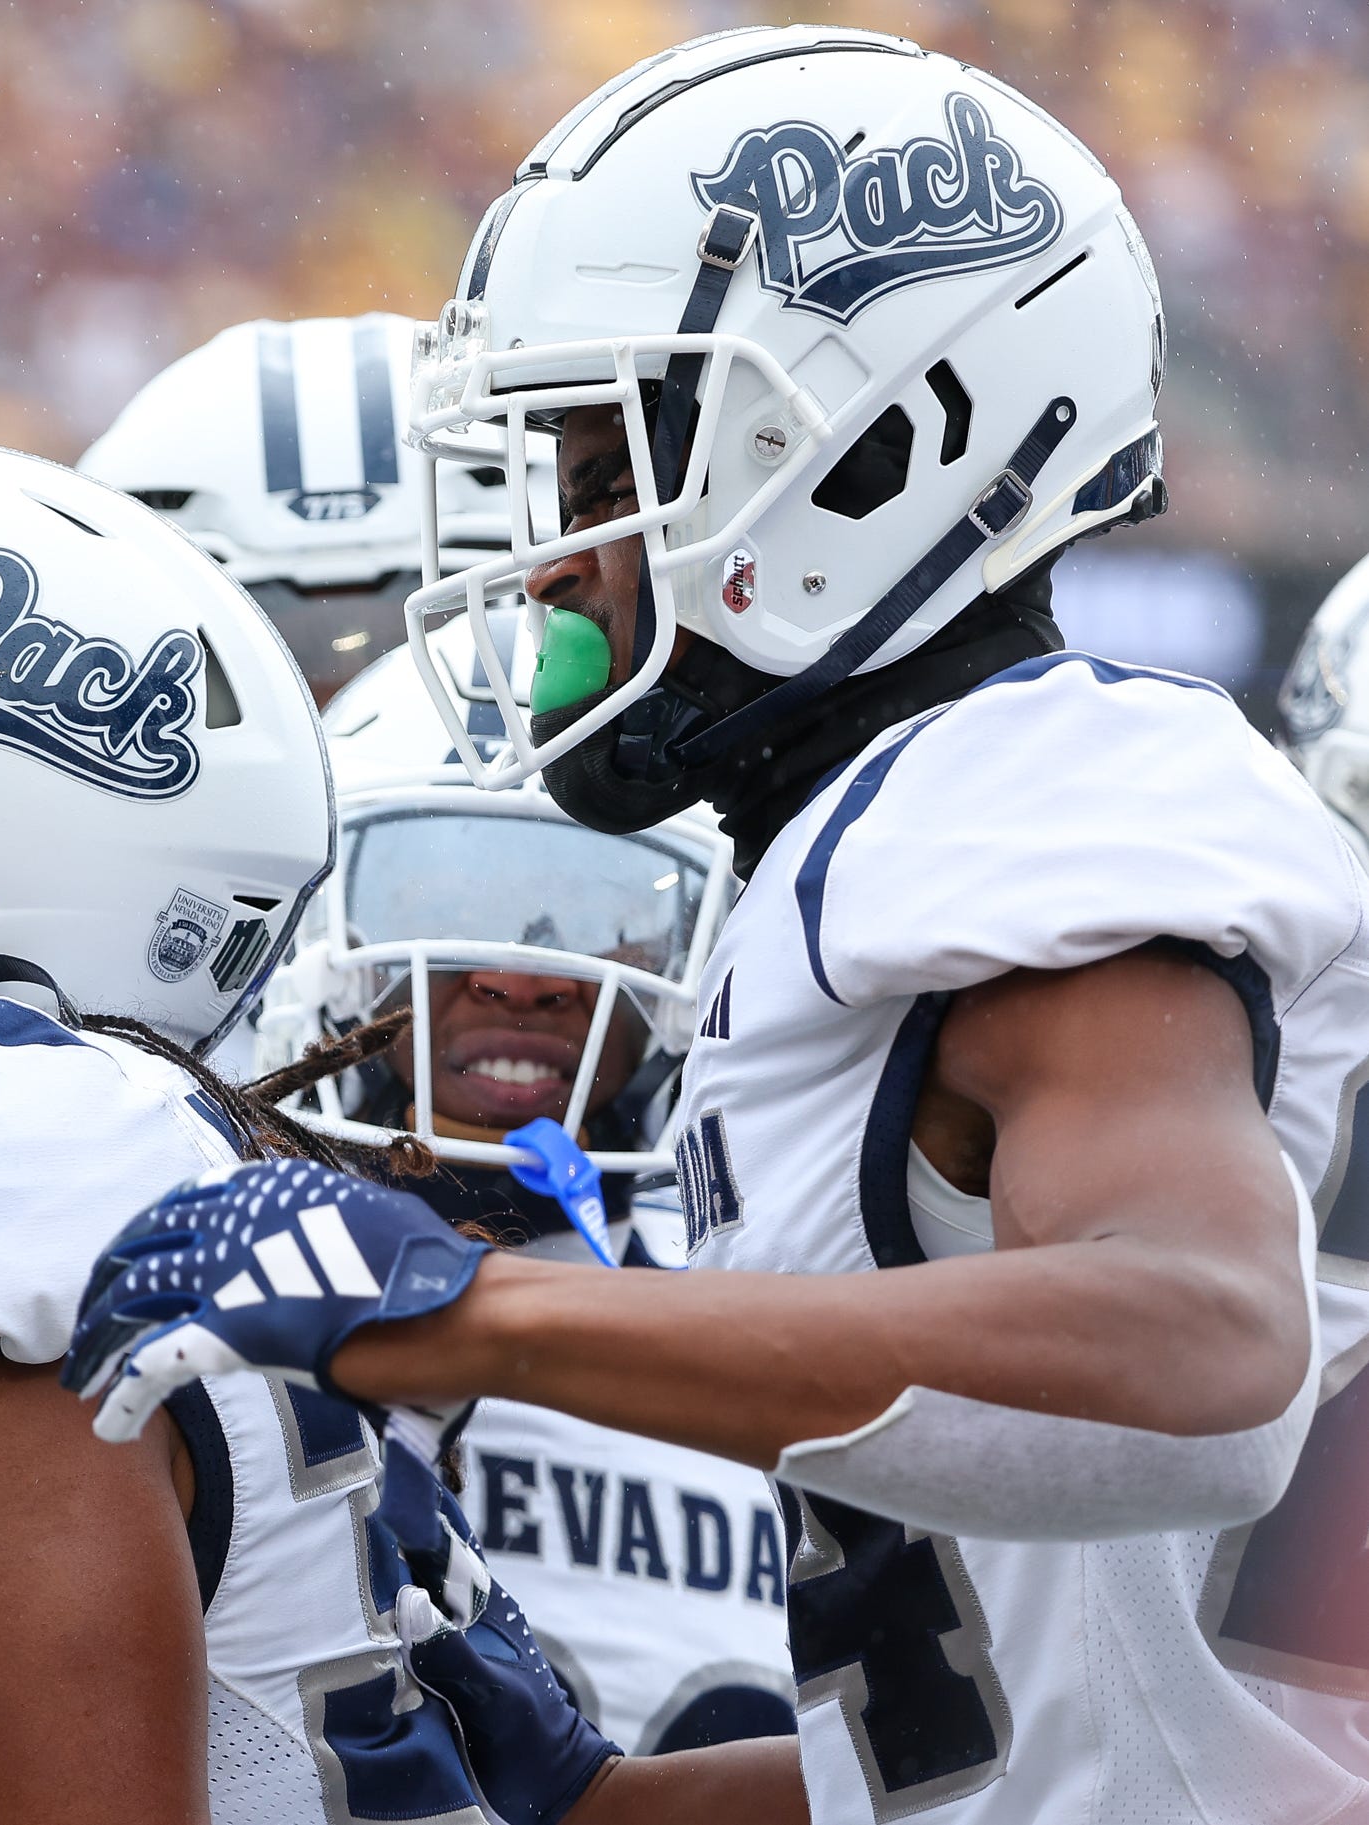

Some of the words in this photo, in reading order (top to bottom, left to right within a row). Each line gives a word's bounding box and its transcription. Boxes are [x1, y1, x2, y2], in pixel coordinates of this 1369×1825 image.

[690, 91, 1064, 330] Pack
[177, 893, 221, 920] UNIVERSITY
[202, 917, 221, 931] RENO
